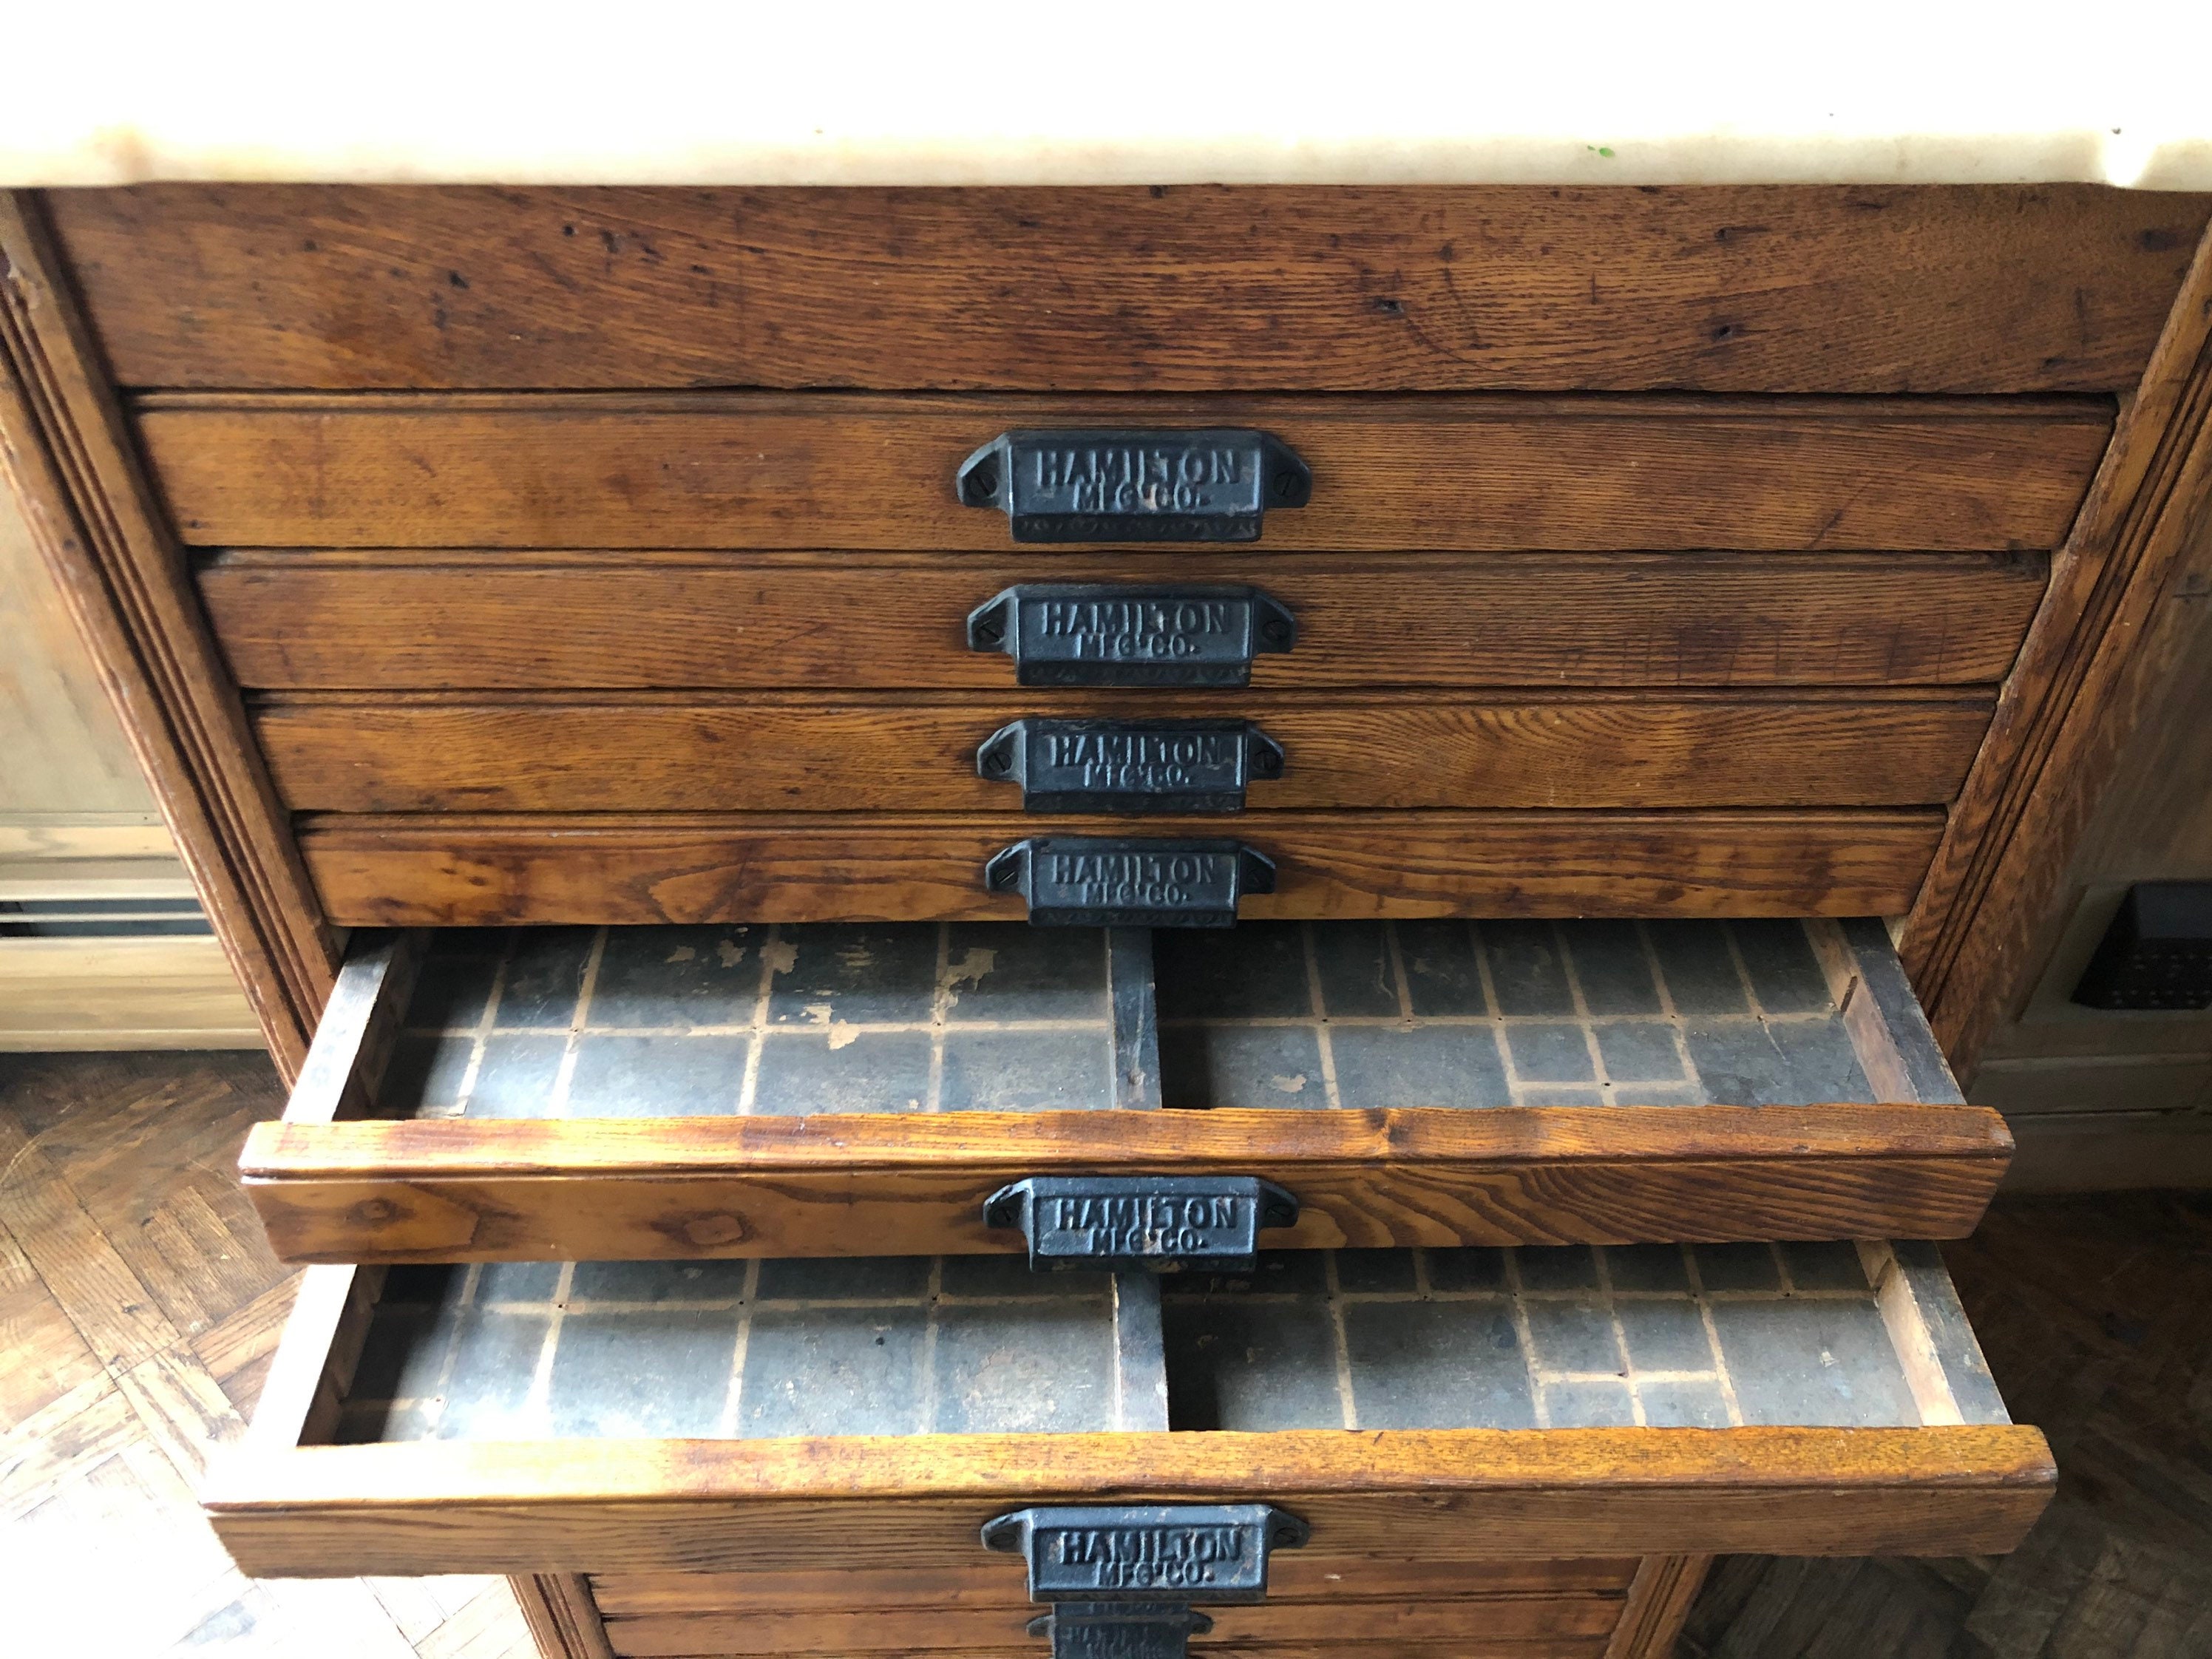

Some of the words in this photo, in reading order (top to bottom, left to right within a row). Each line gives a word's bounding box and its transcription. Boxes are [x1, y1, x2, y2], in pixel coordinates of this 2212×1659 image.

[1036, 449, 1241, 486] HAMILTON
[1042, 602, 1229, 635] HAMILTON
[1049, 734, 1221, 767] HAMILTON
[1052, 854, 1215, 884] HAMILTON
[1055, 1198, 1238, 1230] HAMILTON
[1059, 1530, 1243, 1565] HAMILTON
